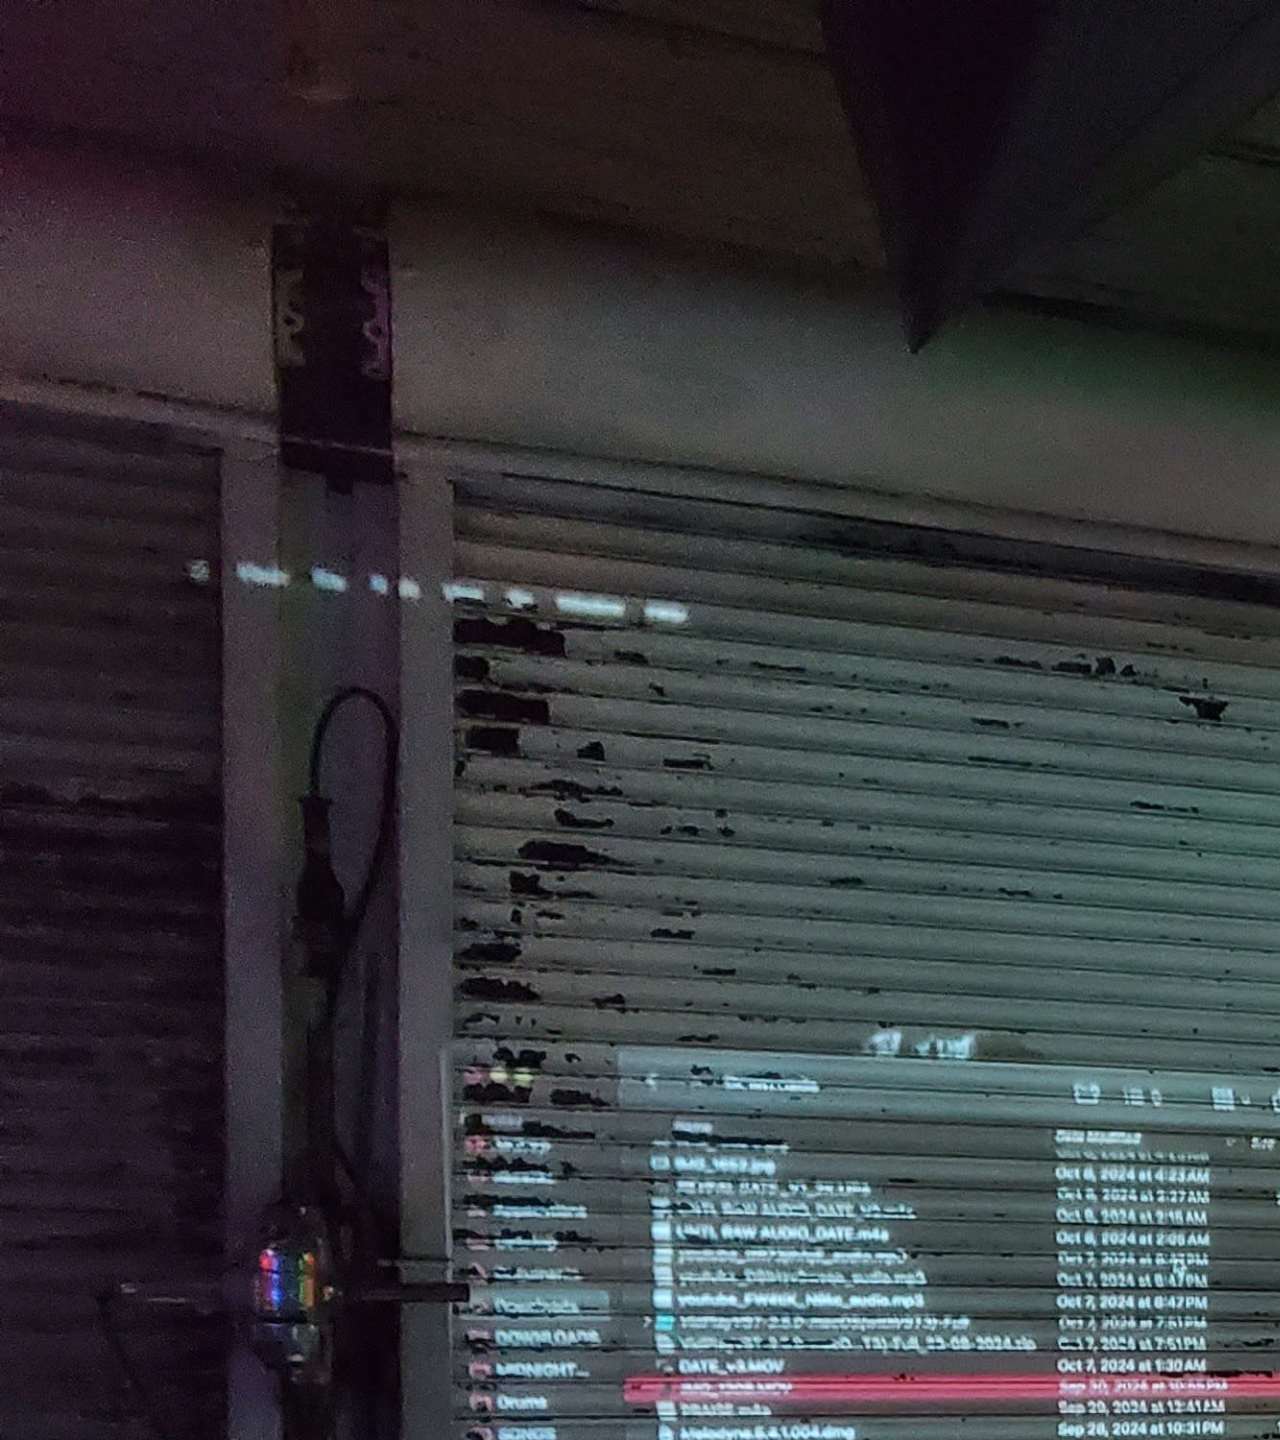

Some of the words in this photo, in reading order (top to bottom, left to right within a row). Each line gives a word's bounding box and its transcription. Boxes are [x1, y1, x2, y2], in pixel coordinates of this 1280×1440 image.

[1100, 1294, 1135, 1309] 2024
[1057, 1358, 1082, 1371] Oct
[1100, 1359, 1135, 1372] 2024
[1138, 1359, 1151, 1372] at
[1155, 1359, 1183, 1372] 1:30
[1184, 1359, 1207, 1372] AM
[1112, 1400, 1148, 1413] 2024
[1058, 1421, 1085, 1437] Sep
[1112, 1421, 1147, 1435] 2024
[1167, 1421, 1201, 1434] 10:31
[1202, 1420, 1224, 1434] PM
